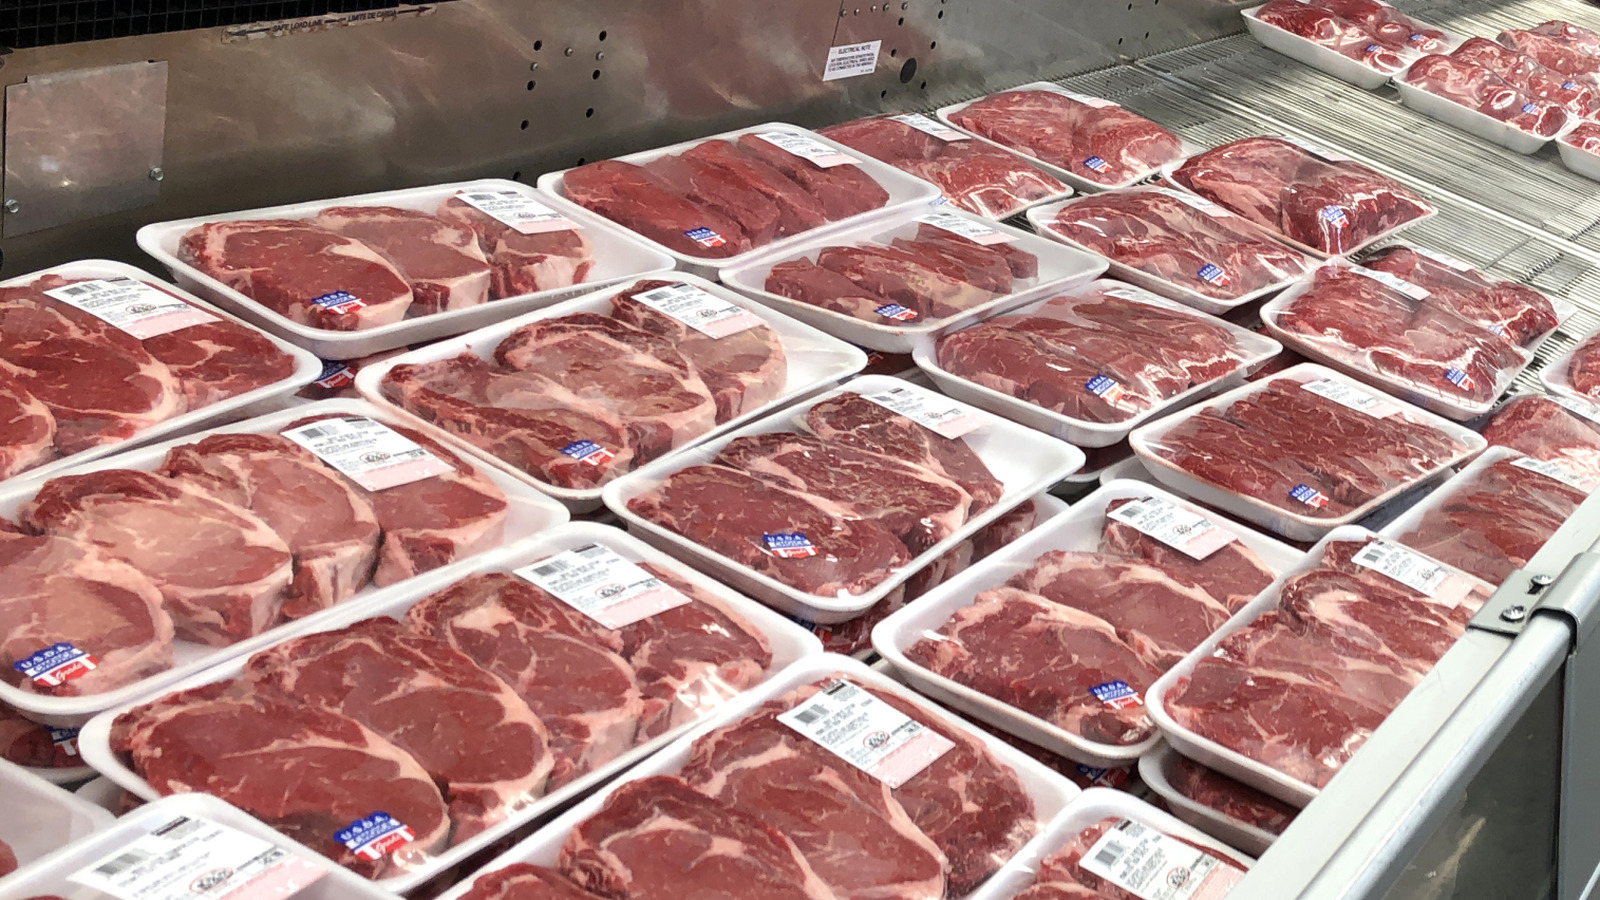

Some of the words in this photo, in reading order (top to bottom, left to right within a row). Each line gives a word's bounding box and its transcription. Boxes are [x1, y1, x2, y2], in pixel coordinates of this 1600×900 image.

[347, 12, 366, 21] LIMITE
[367, 11, 376, 19] DE
[272, 24, 289, 32] SAFE
[290, 20, 308, 29] LOAD
[308, 18, 323, 27] LINE
